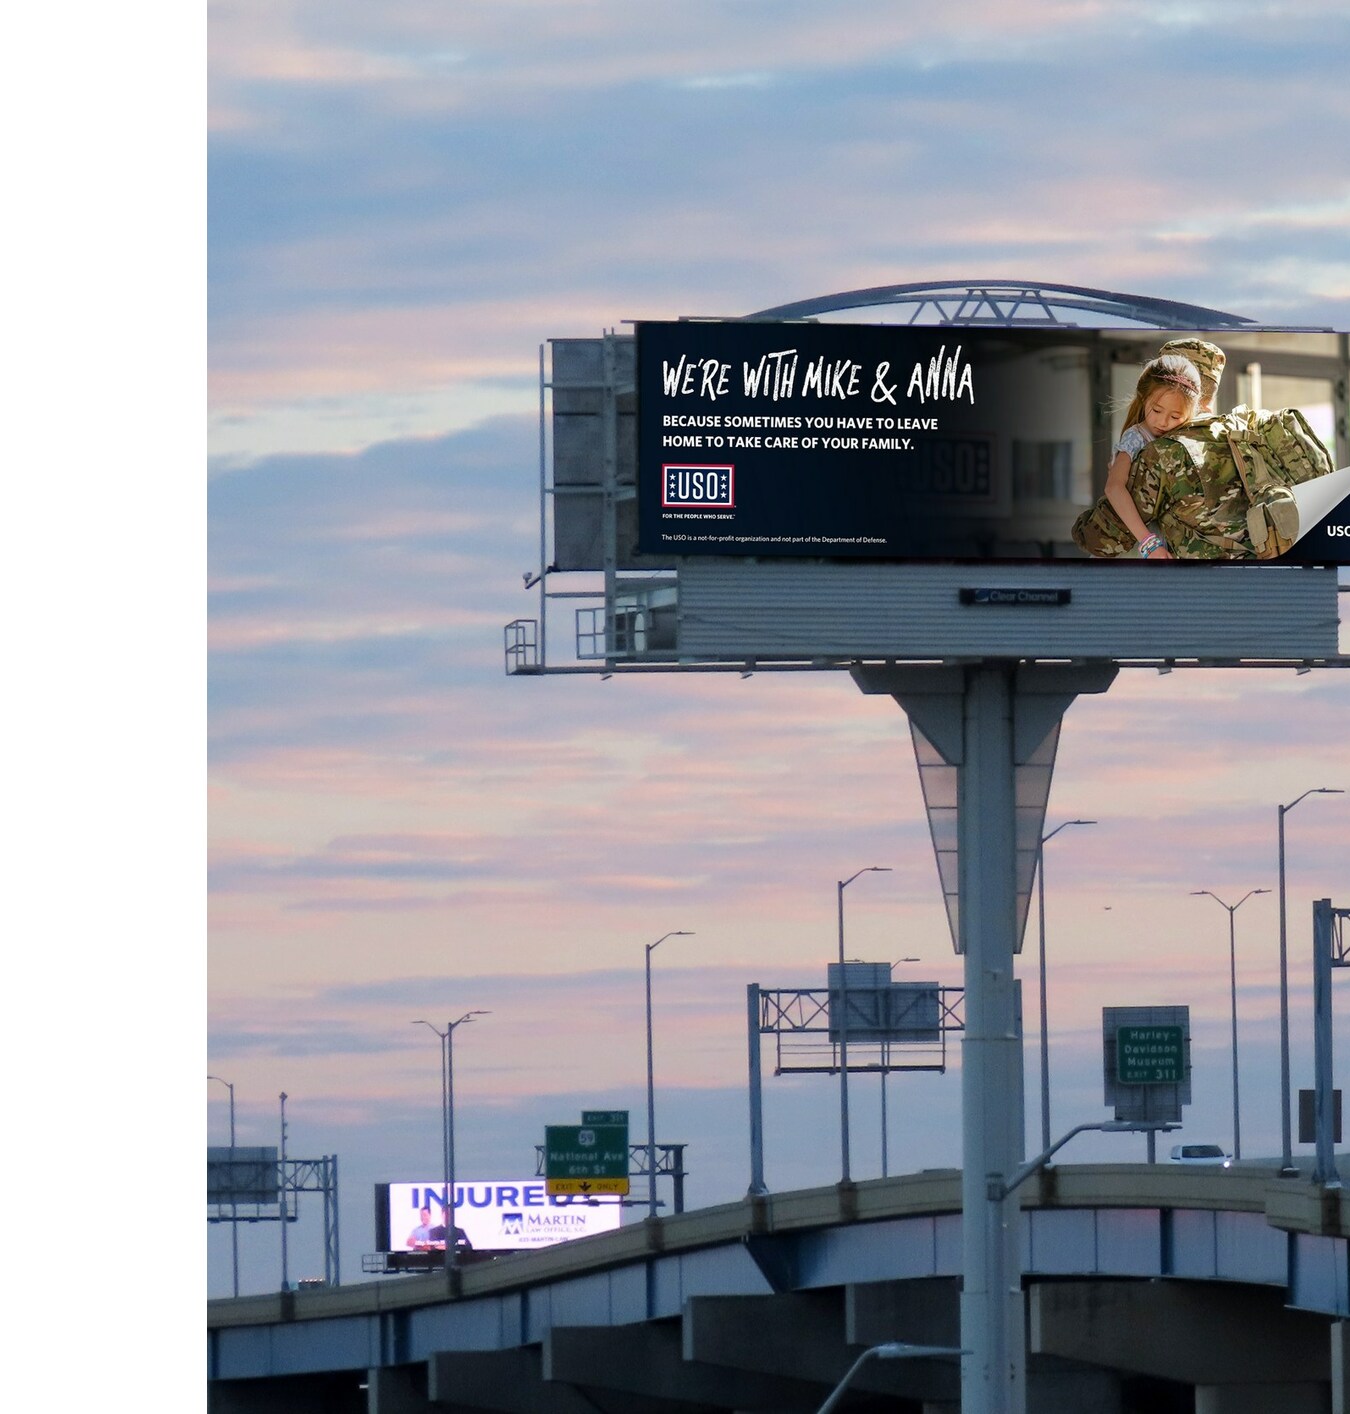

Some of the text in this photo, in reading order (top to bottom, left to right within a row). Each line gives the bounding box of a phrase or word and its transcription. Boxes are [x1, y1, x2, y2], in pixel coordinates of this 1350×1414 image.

[663, 345, 974, 405] WE'RE WITH MIKE & ANNA
[663, 415, 938, 429] BECAUSE SOMETIMES YOU HAVE TO LEAVE
[663, 435, 914, 449] HOME TO TAKE CARE OF YOUR FAMILY.
[679, 472, 718, 500] USO
[698, 534, 734, 542] not-for-profit
[735, 535, 769, 543] organization
[822, 536, 855, 544] Department
[863, 536, 887, 544] Defense.
[990, 590, 1059, 601] Clear Channel
[1130, 1030, 1177, 1041] Harley-
[1124, 1044, 1178, 1054] Davidson
[1127, 1057, 1175, 1066] Museum
[1155, 1069, 1177, 1079] 311
[550, 1152, 624, 1161] National Ave
[568, 1165, 607, 1175] 6th St
[555, 1182, 618, 1191] EXIT ONLY
[412, 1186, 590, 1209] INJURED
[527, 1213, 586, 1225] MARTIN
